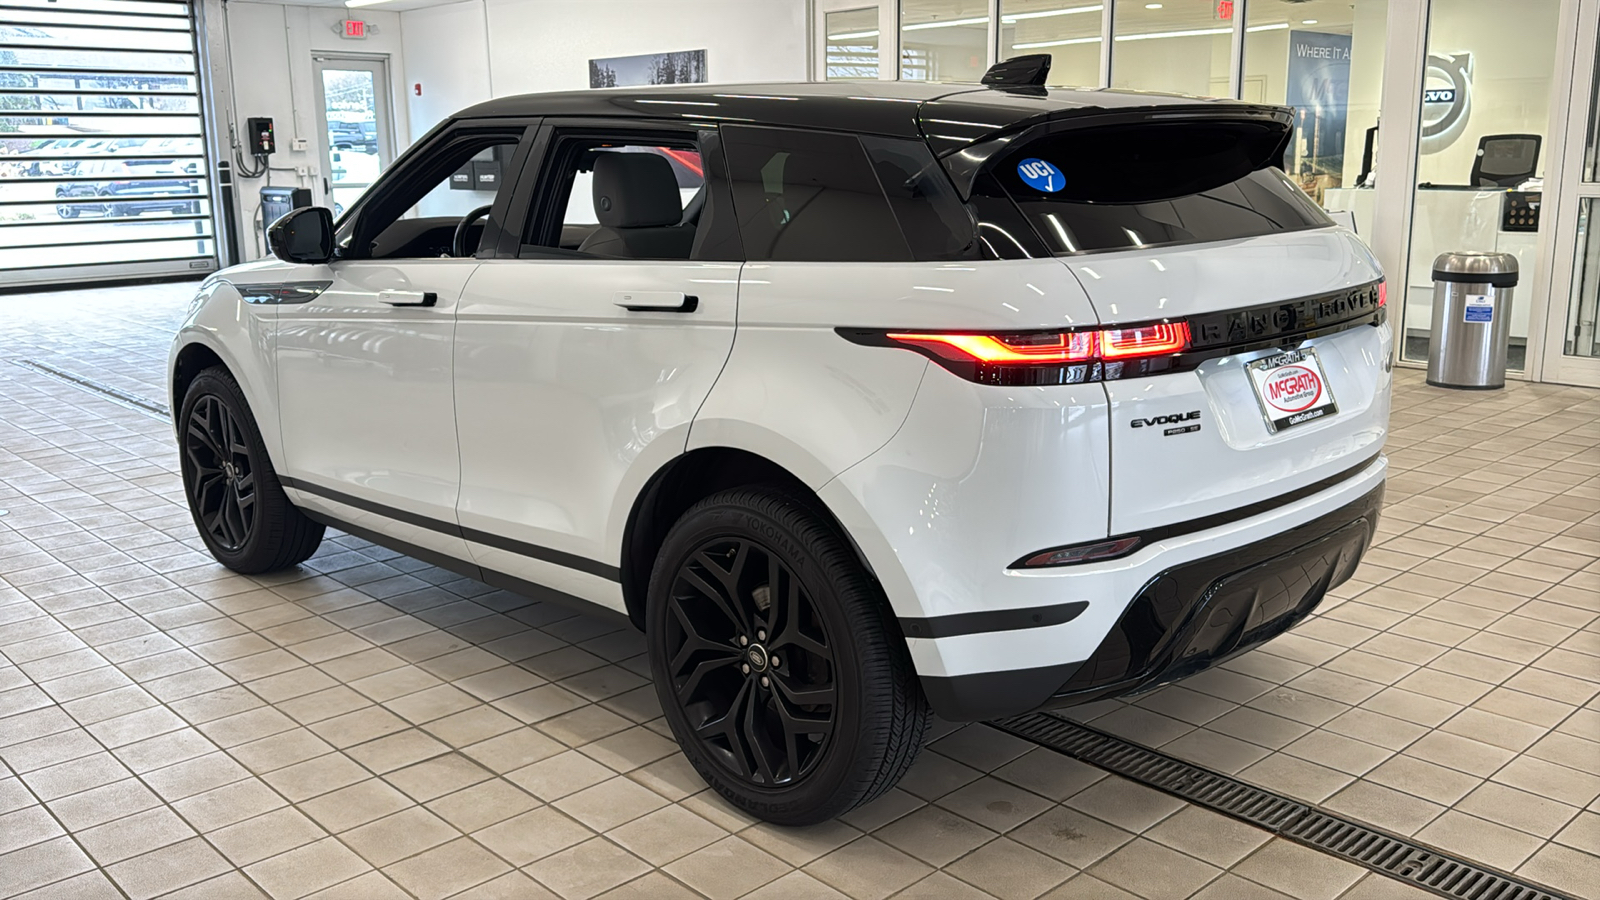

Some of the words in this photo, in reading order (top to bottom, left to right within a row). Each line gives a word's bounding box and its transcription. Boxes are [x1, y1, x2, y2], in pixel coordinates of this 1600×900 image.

[346, 20, 364, 37] EXIT
[1296, 43, 1332, 59] WHERE
[1341, 47, 1351, 60] A
[1019, 160, 1055, 180] UCI
[1201, 303, 1306, 342] RANGE
[1318, 285, 1378, 320] ROVER
[1130, 410, 1201, 428] EVOQUE
[745, 515, 806, 570] YOKOHAMA
